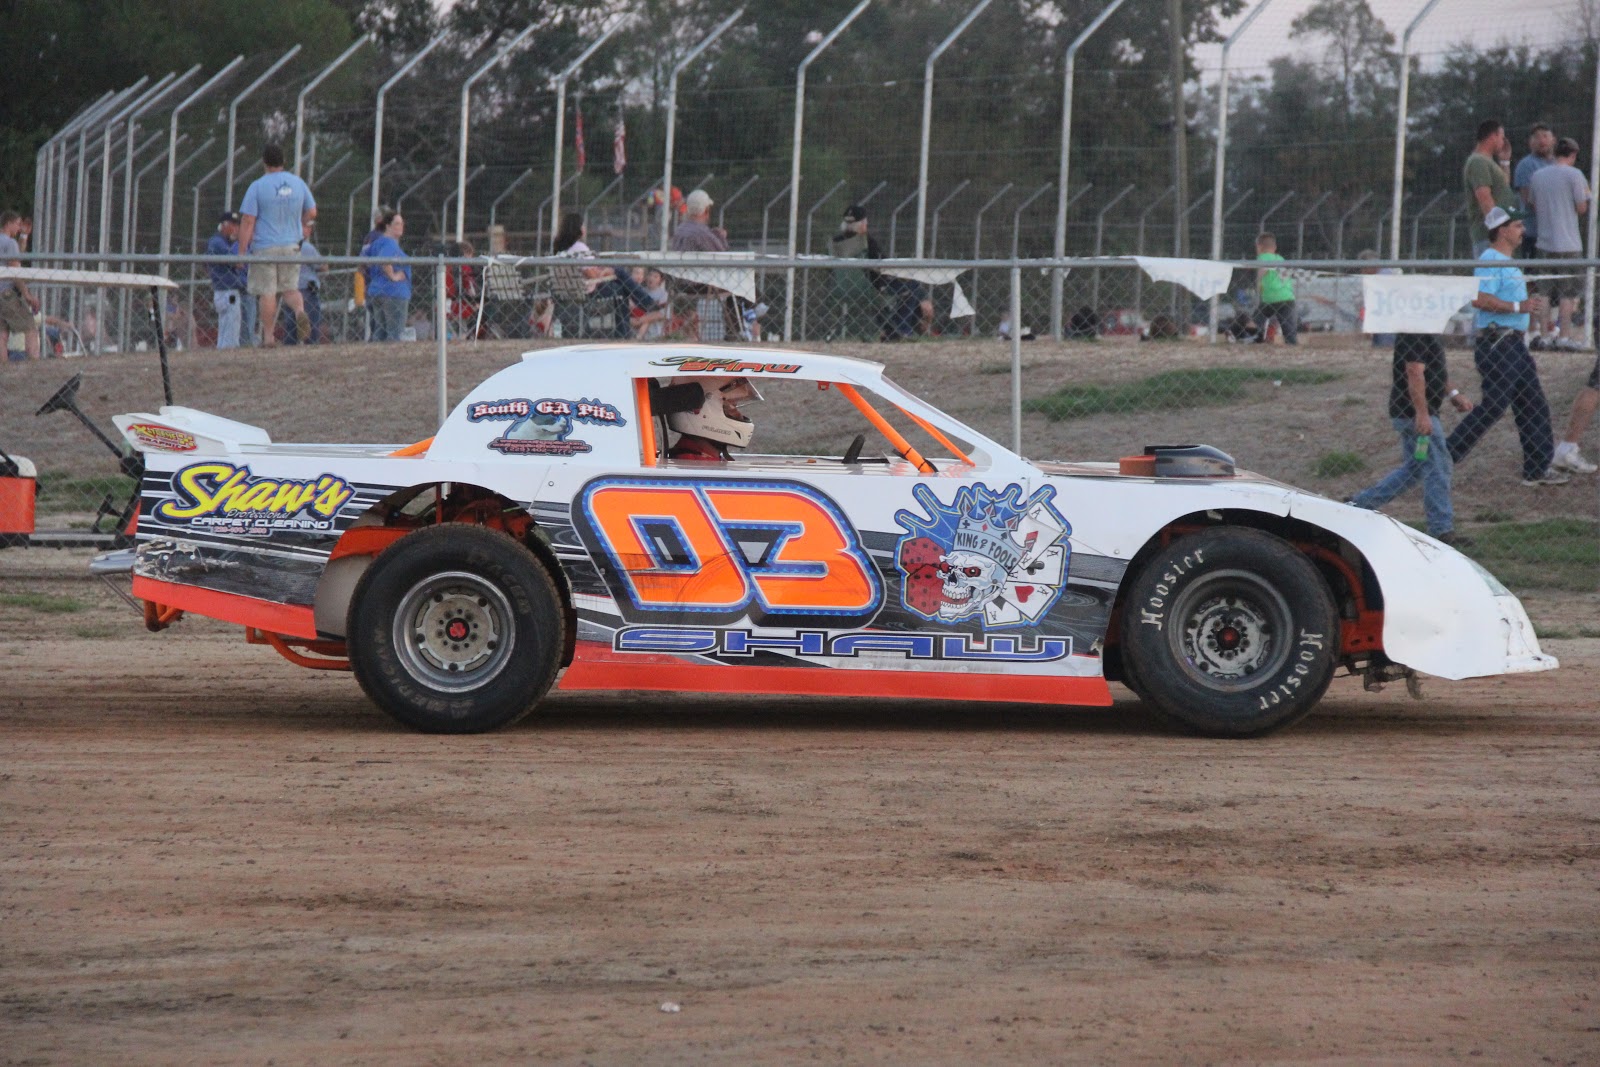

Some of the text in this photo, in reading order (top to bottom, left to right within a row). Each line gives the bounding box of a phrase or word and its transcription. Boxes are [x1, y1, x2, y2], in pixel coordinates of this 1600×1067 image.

[678, 361, 803, 374] SHAW
[473, 401, 617, 421] South GA Pits
[160, 464, 353, 518] Shaw's
[191, 517, 329, 528] CARPET CLEANING
[226, 508, 292, 519] Professional
[588, 481, 877, 612] 03
[956, 532, 1018, 570] KING OF FOOLS
[1141, 549, 1203, 631] Hoosier
[612, 623, 1073, 662] SHAW
[1260, 628, 1324, 710] Hoosier
